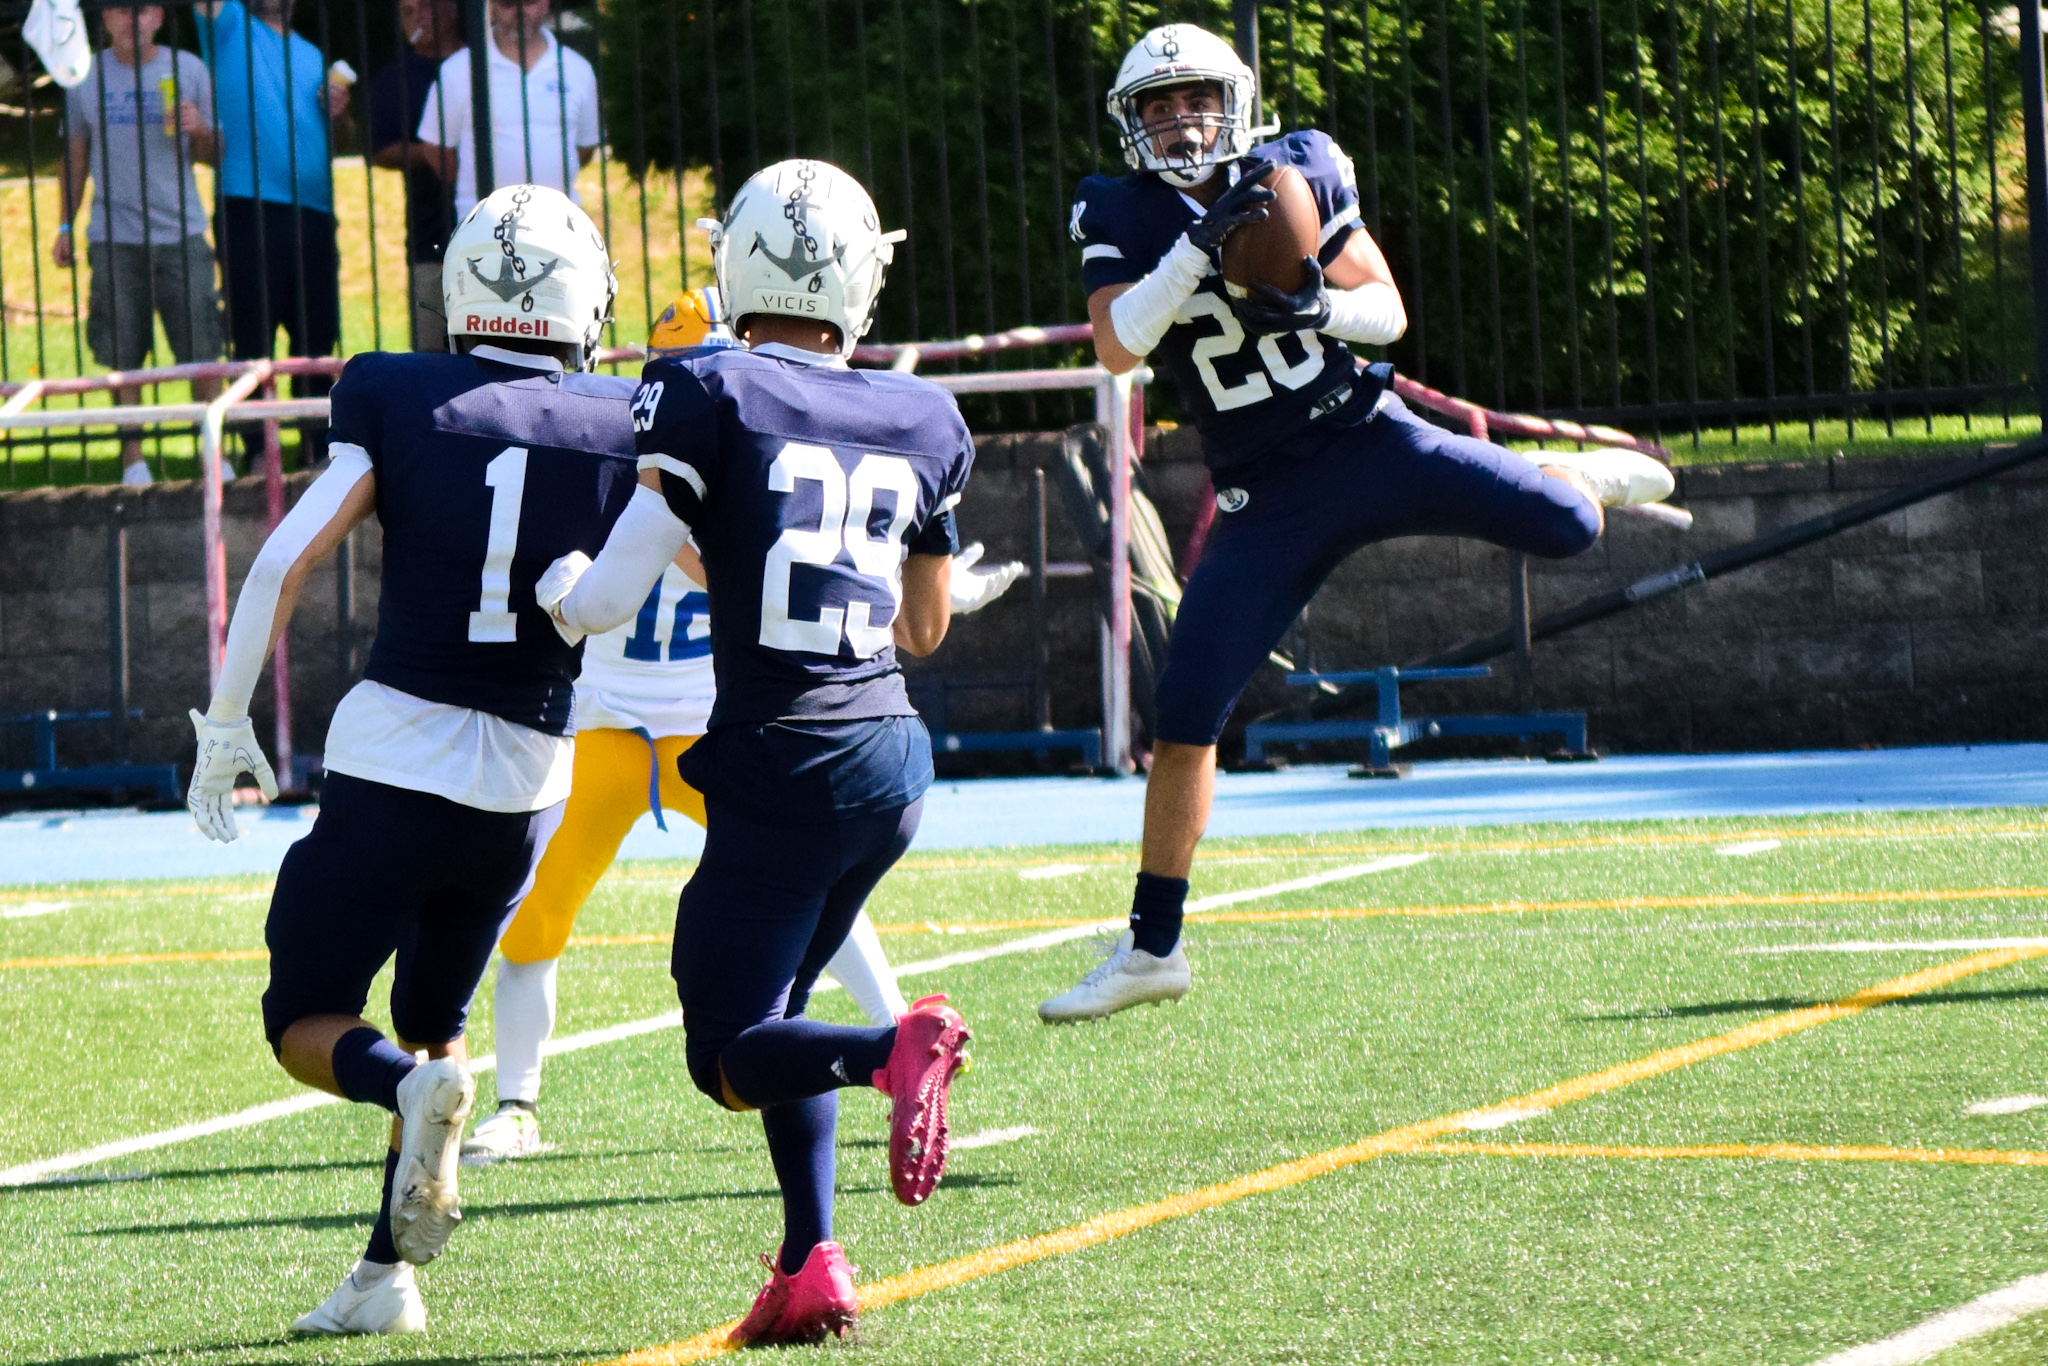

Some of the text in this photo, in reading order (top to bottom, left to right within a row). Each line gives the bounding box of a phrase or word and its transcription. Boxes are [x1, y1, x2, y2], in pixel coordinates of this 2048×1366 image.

[466, 314, 549, 337] Riddell
[761, 295, 817, 313] VICIS
[629, 380, 665, 433] 29
[468, 446, 528, 643] 1
[758, 442, 920, 660] 29
